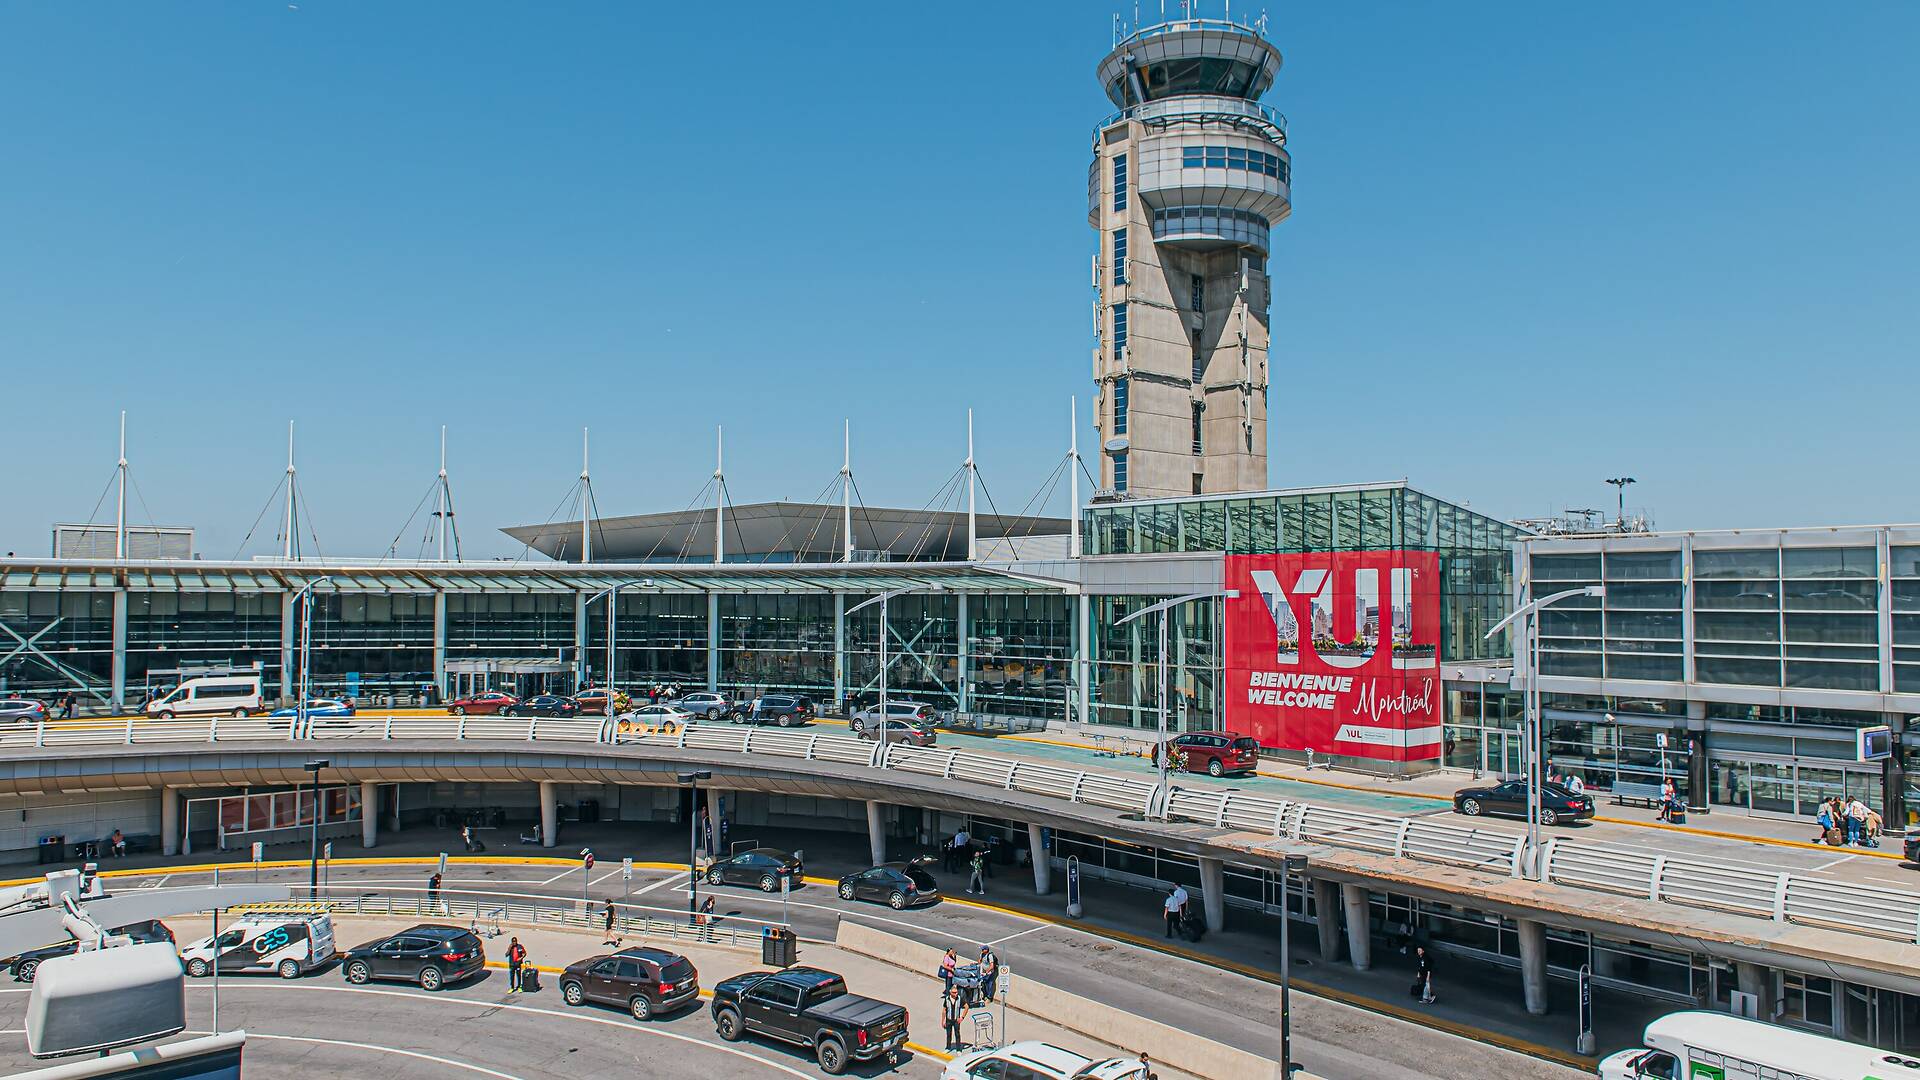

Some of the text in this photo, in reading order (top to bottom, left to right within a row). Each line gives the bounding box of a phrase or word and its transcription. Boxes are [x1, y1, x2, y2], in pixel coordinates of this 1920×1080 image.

[1250, 568, 1435, 669] YUL
[1250, 672, 1353, 692] BIENVENUE
[1248, 689, 1336, 710] WELCOME
[1353, 677, 1432, 721] Montréal
[1346, 729, 1363, 739] YUL
[253, 927, 288, 953] CES
